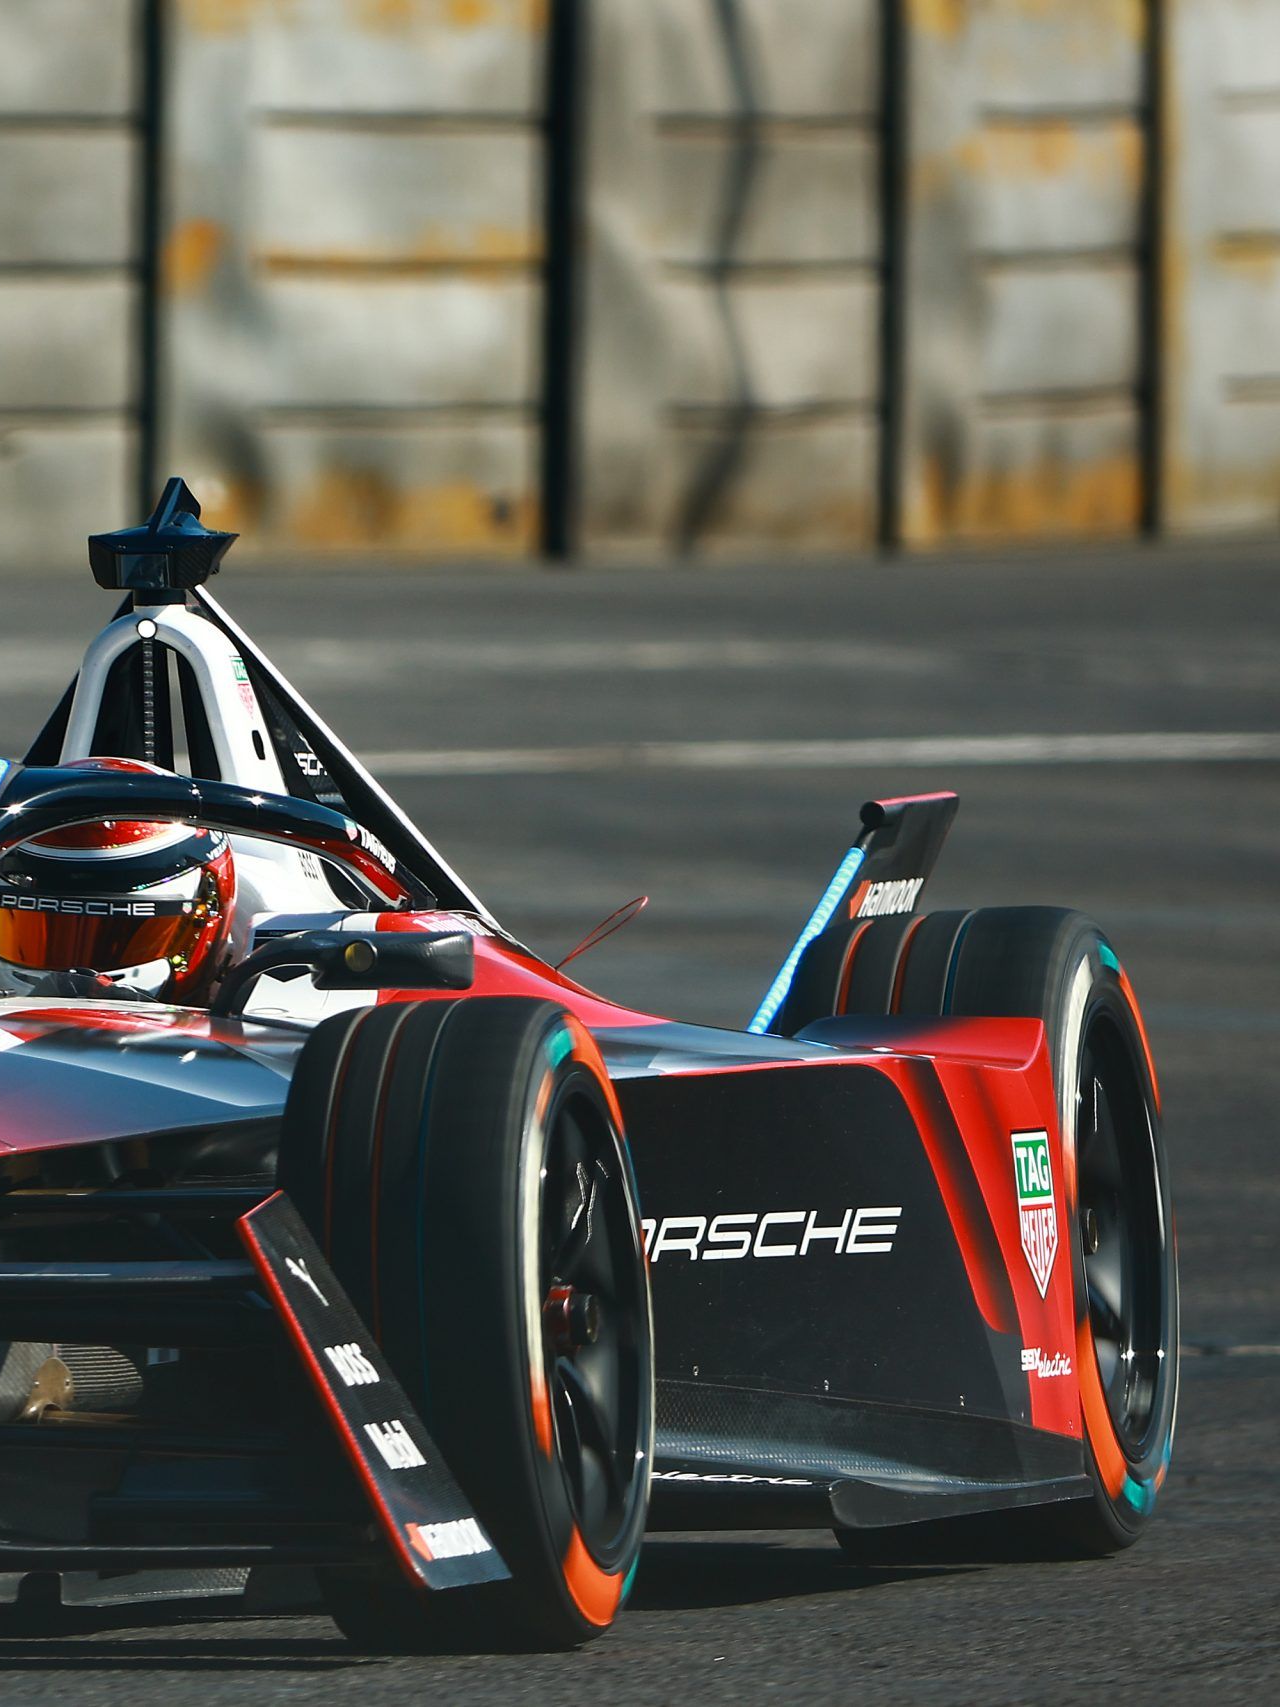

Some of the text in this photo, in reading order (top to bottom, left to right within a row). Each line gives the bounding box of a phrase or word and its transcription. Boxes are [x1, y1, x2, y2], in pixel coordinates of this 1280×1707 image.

[0, 894, 156, 917] PORSCHE
[1015, 1144, 1050, 1193] TAG
[1021, 1207, 1056, 1280] HEUER
[324, 1342, 381, 1387] BOSS
[1020, 1346, 1072, 1379] 99X electric
